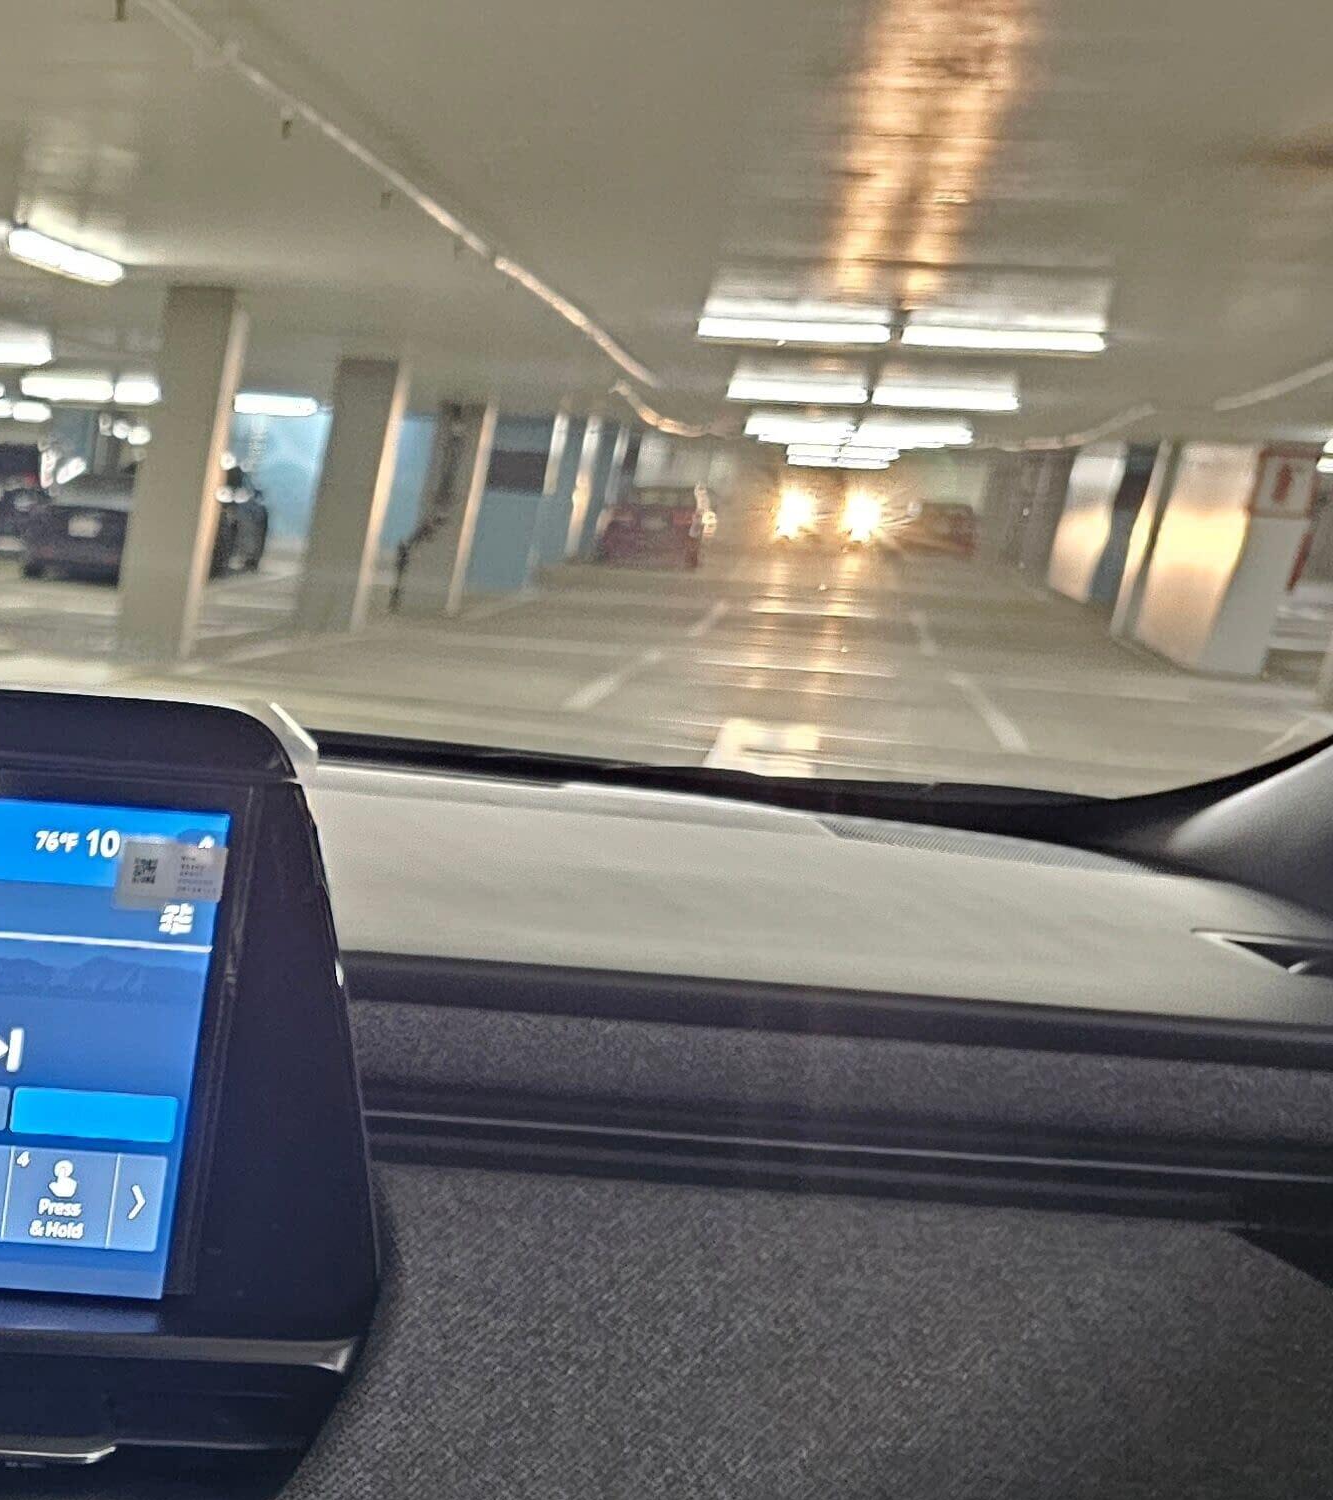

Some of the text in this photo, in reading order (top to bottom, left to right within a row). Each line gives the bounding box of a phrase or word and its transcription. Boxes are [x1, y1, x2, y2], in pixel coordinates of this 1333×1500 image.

[16, 1151, 31, 1168] 4
[38, 1198, 82, 1218] Press
[29, 1220, 84, 1240] & Hold
